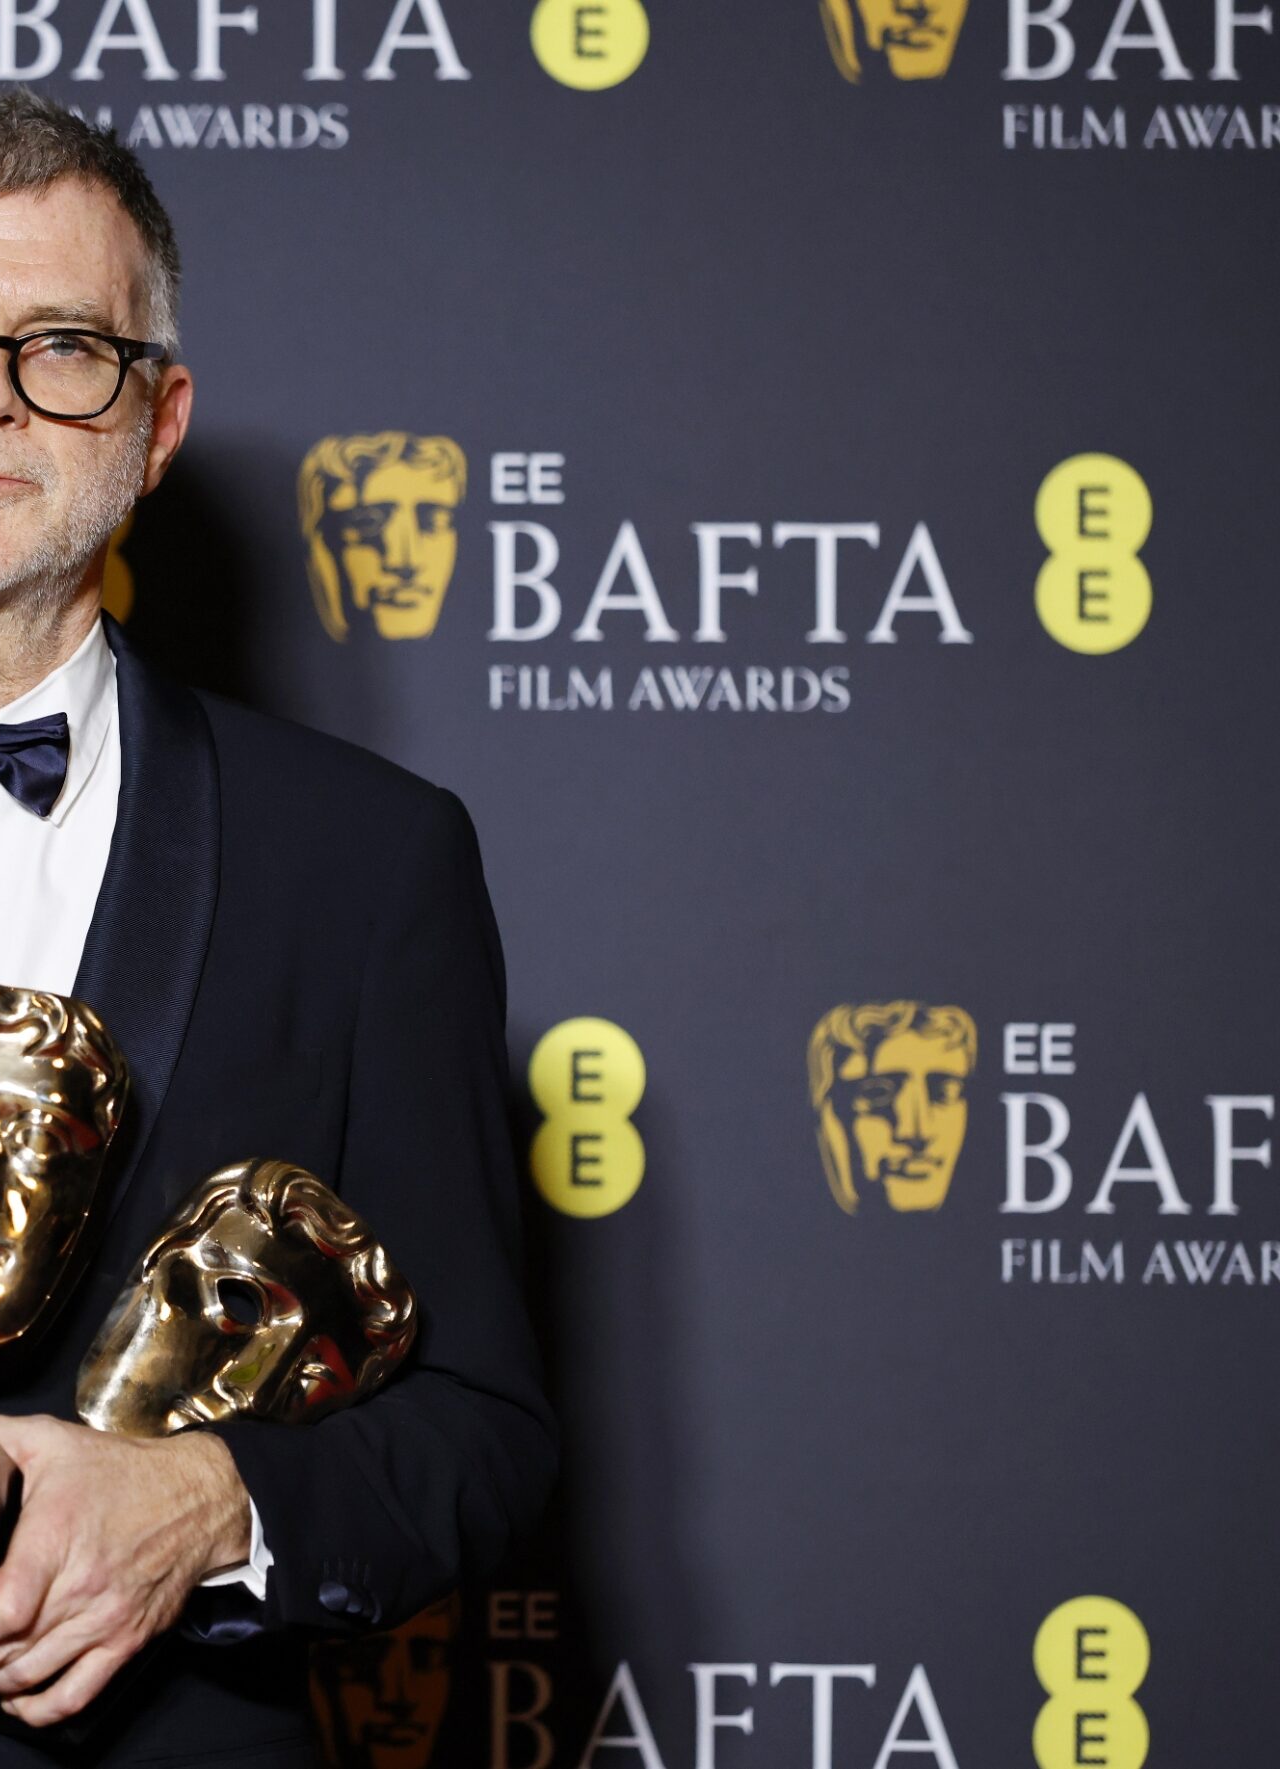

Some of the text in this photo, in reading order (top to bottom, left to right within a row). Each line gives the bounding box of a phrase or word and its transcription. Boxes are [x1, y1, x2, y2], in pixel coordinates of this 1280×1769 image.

[126, 104, 350, 149] AWARDS
[1002, 104, 1127, 149] FILM
[489, 452, 565, 505] EE
[486, 520, 974, 645] BAFTA
[488, 664, 851, 713] FILM AWARDS
[1003, 1022, 1076, 1075] EE
[1000, 1238, 1125, 1284] FILM
[489, 1592, 560, 1640] EE
[488, 1660, 962, 1769] BAFTA
